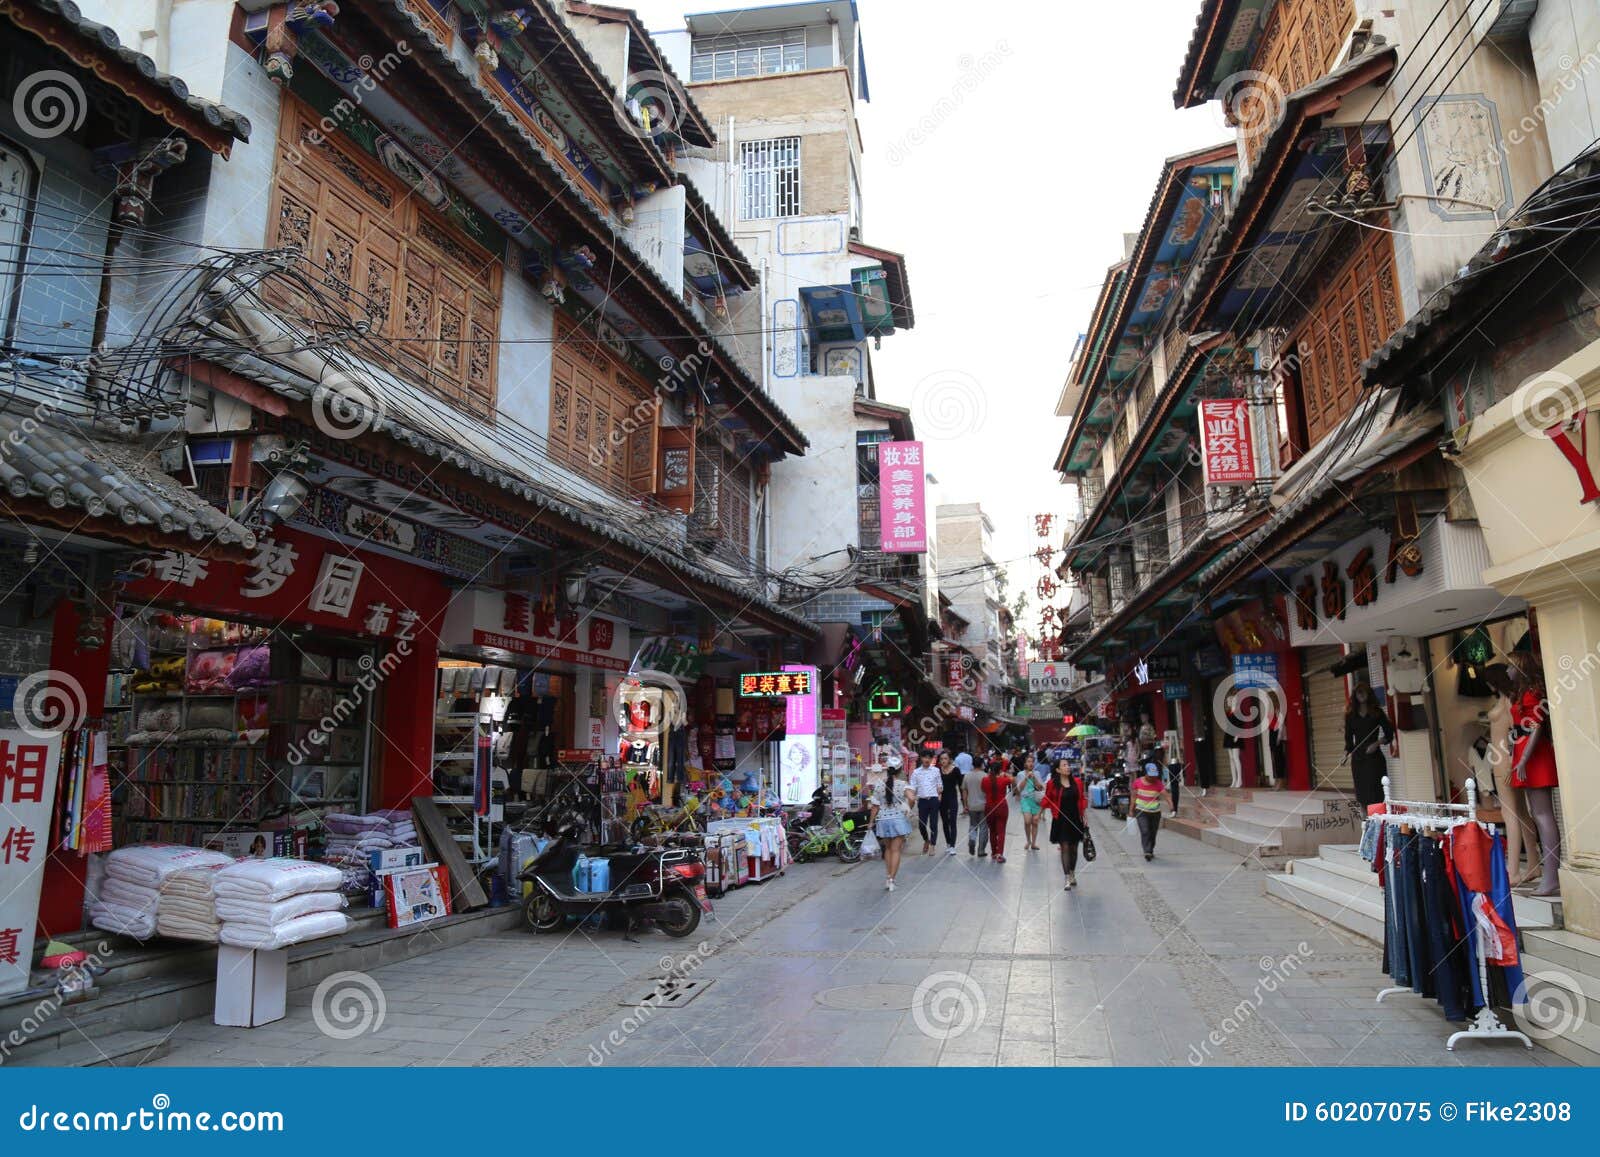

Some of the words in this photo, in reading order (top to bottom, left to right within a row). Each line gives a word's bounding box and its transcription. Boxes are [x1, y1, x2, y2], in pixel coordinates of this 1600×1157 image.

[1204, 402, 1240, 472] 专业纹绣
[1543, 408, 1600, 504] Y
[743, 674, 808, 692] 婴装童车
